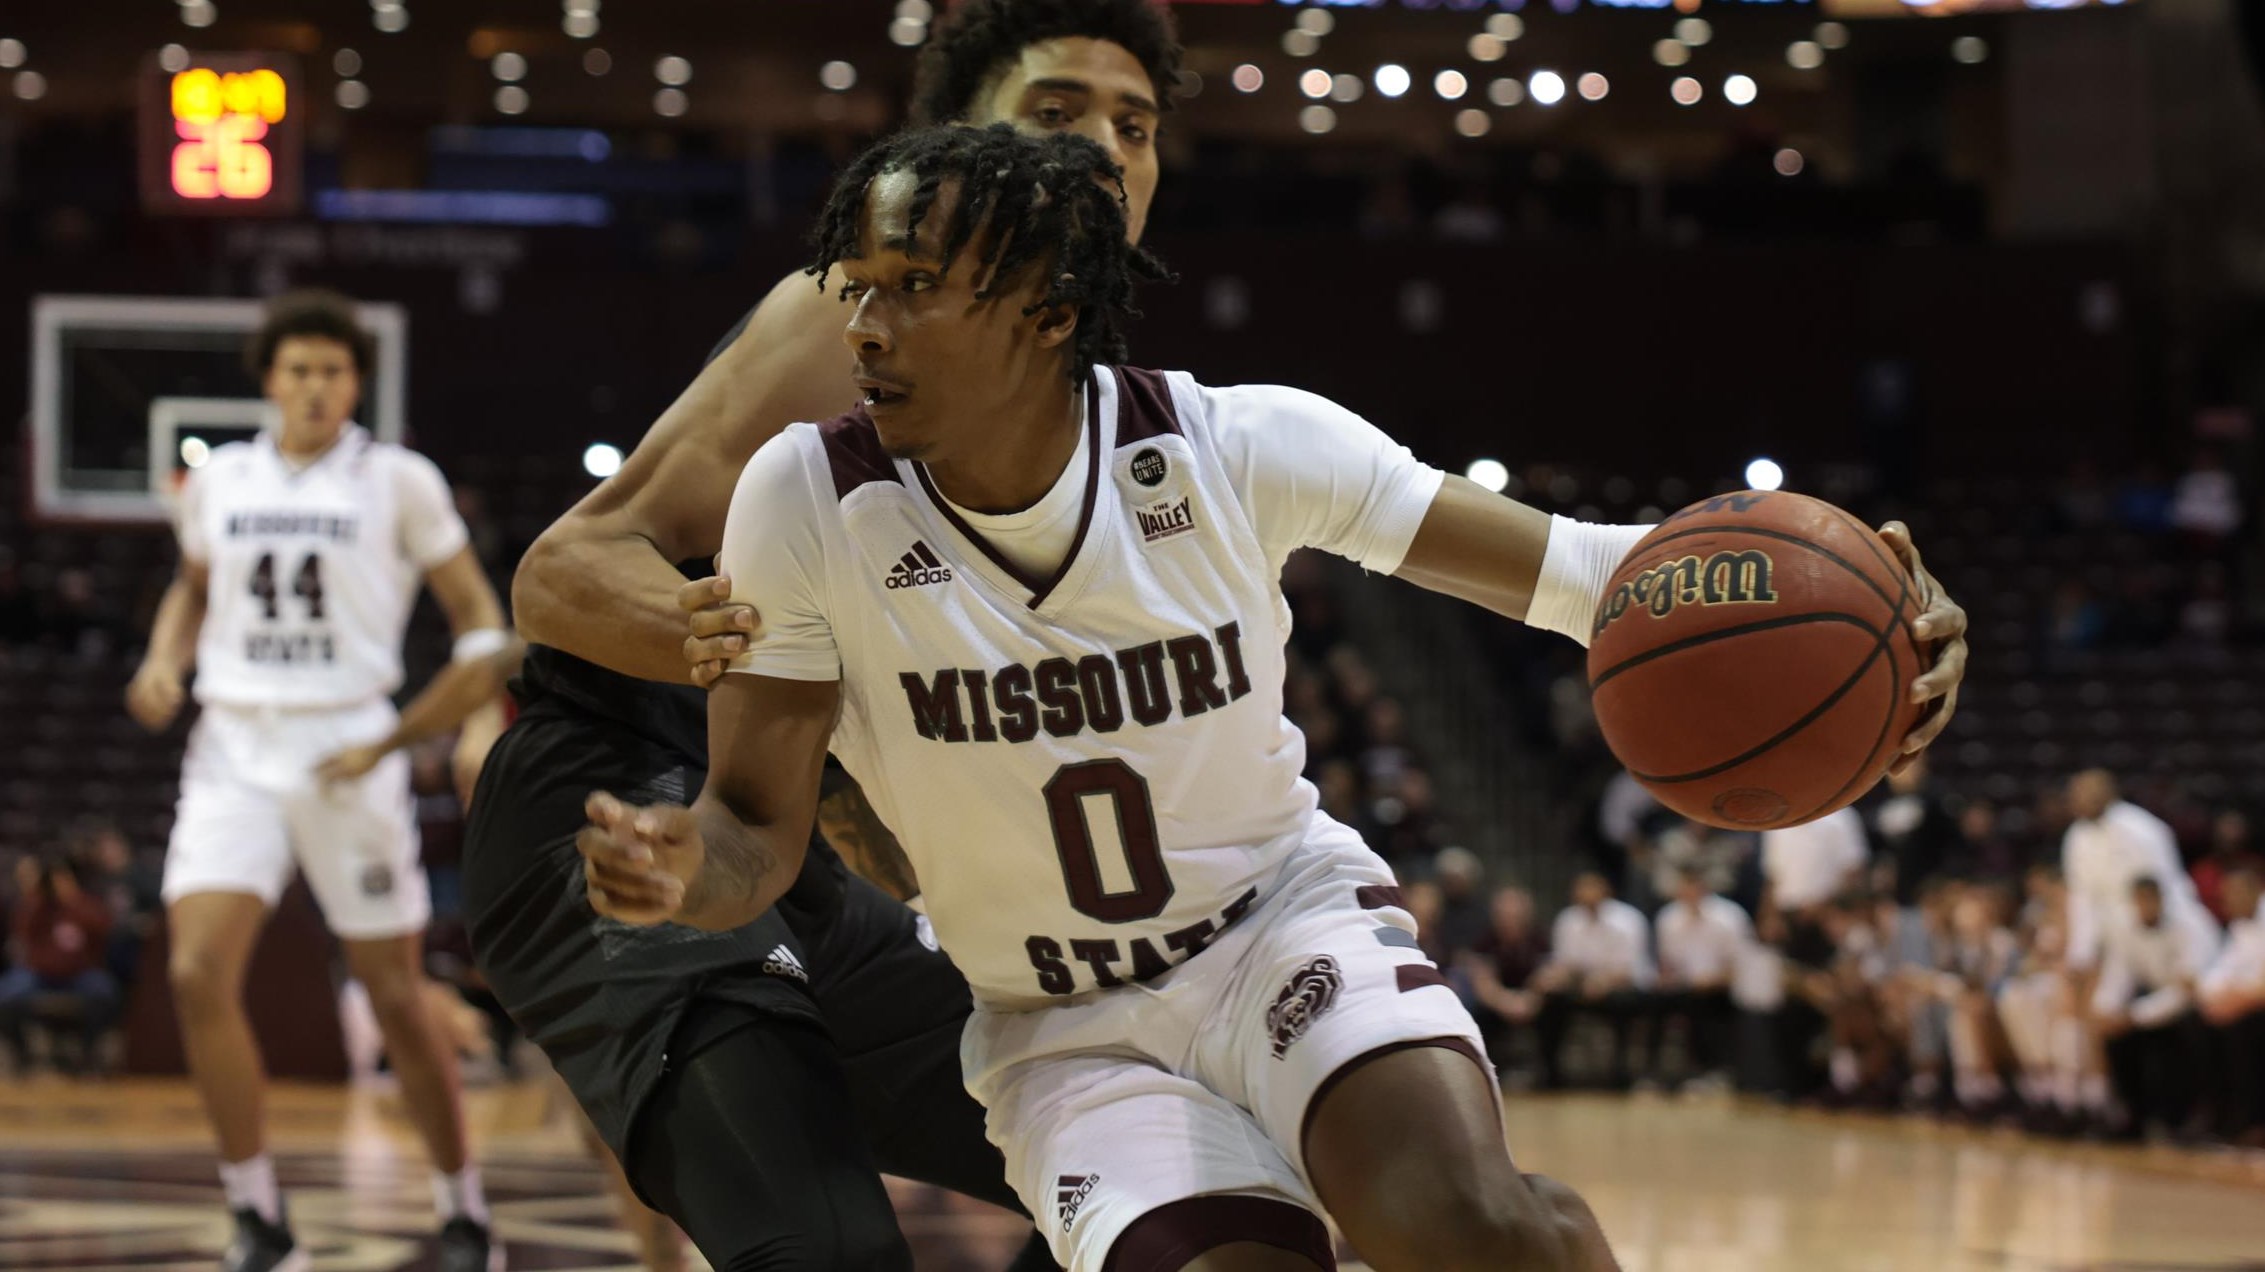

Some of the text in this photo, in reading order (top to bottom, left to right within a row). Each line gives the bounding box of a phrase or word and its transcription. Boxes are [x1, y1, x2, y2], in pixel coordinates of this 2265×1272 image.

[1135, 462, 1164, 481] UNITE
[1136, 496, 1193, 536] VALLEY
[1153, 502, 1169, 512] THE
[247, 551, 325, 620] 44
[885, 567, 952, 589] adidas
[899, 620, 1251, 744] MISSOURI
[1041, 756, 1175, 924] 0
[1063, 1173, 1100, 1233] adidas
